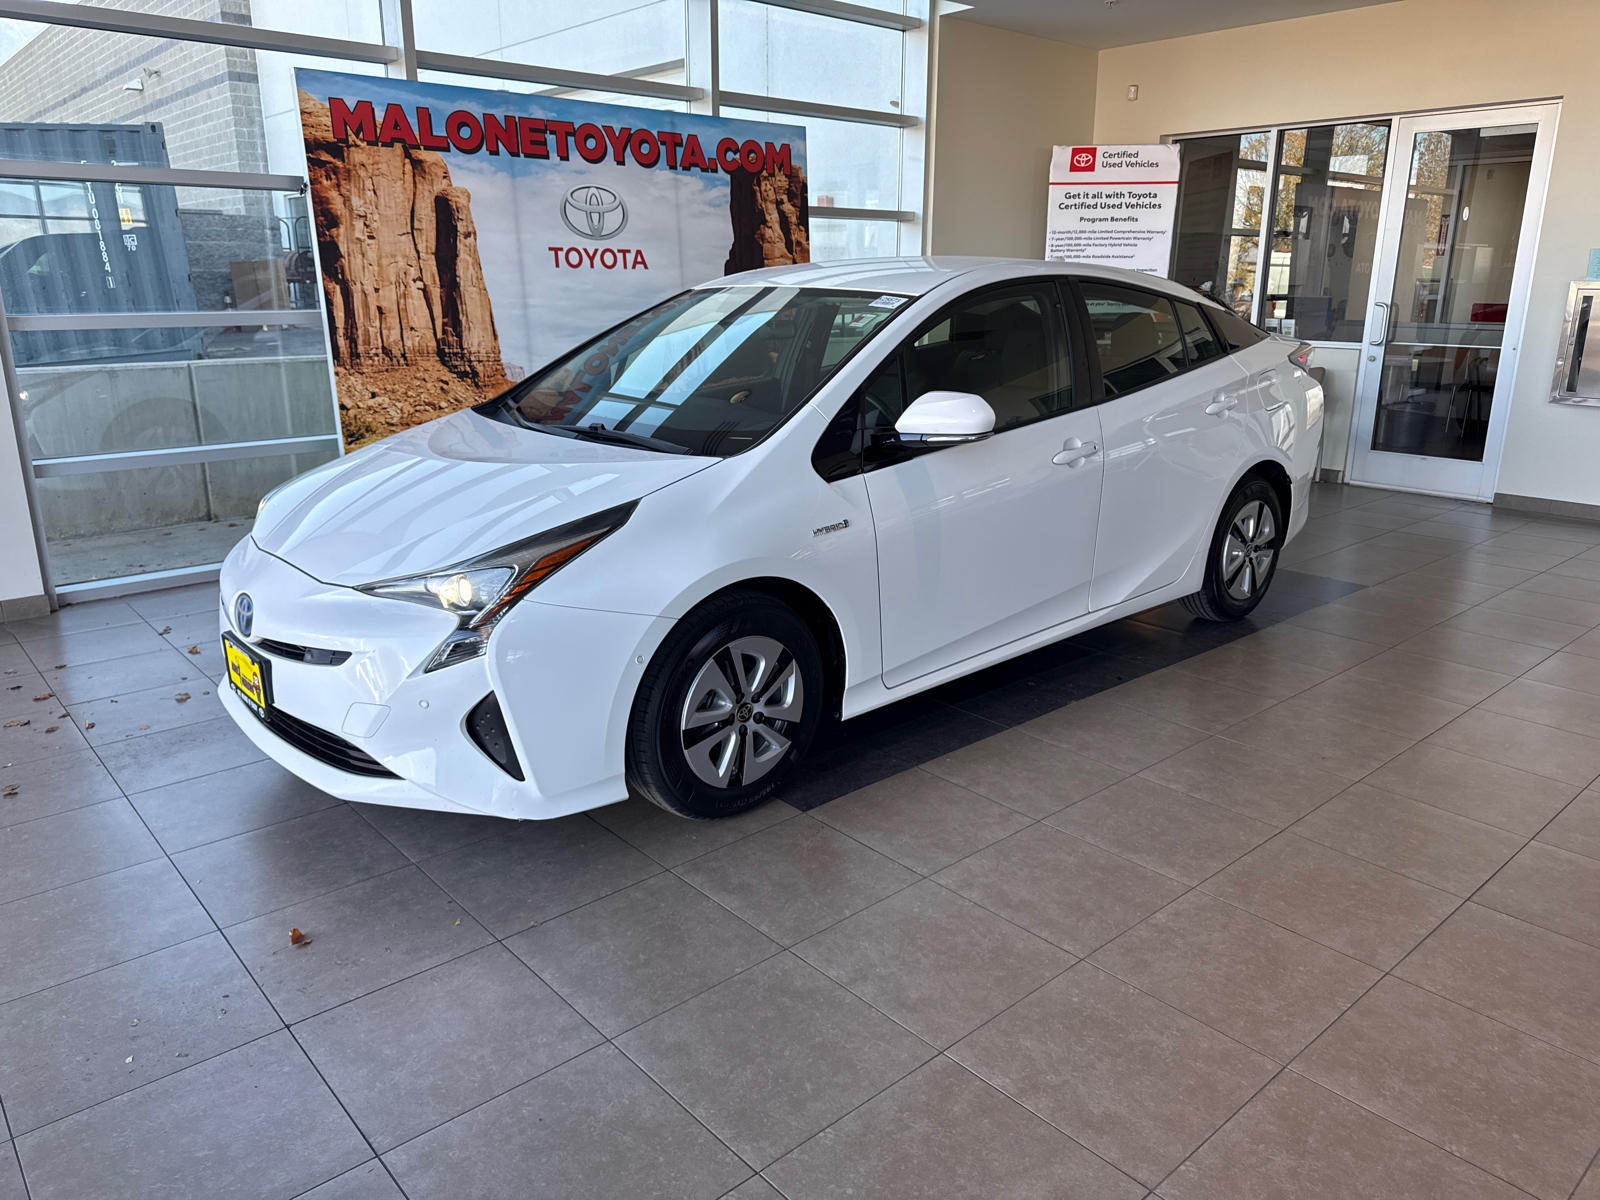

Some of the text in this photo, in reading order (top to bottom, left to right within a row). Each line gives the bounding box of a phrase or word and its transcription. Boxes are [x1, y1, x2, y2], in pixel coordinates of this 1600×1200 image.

[328, 97, 792, 176] MALONETOYOTA.COM
[1102, 150, 1139, 159] Certified
[1101, 160, 1159, 169] Used Vehicles
[1064, 191, 1158, 201] Get it all with Toyota
[1058, 201, 1162, 210] Certified Used Vehicles
[1110, 215, 1139, 223] Benefits
[548, 247, 649, 270] TOYOTA
[811, 521, 846, 538] HYBRID
